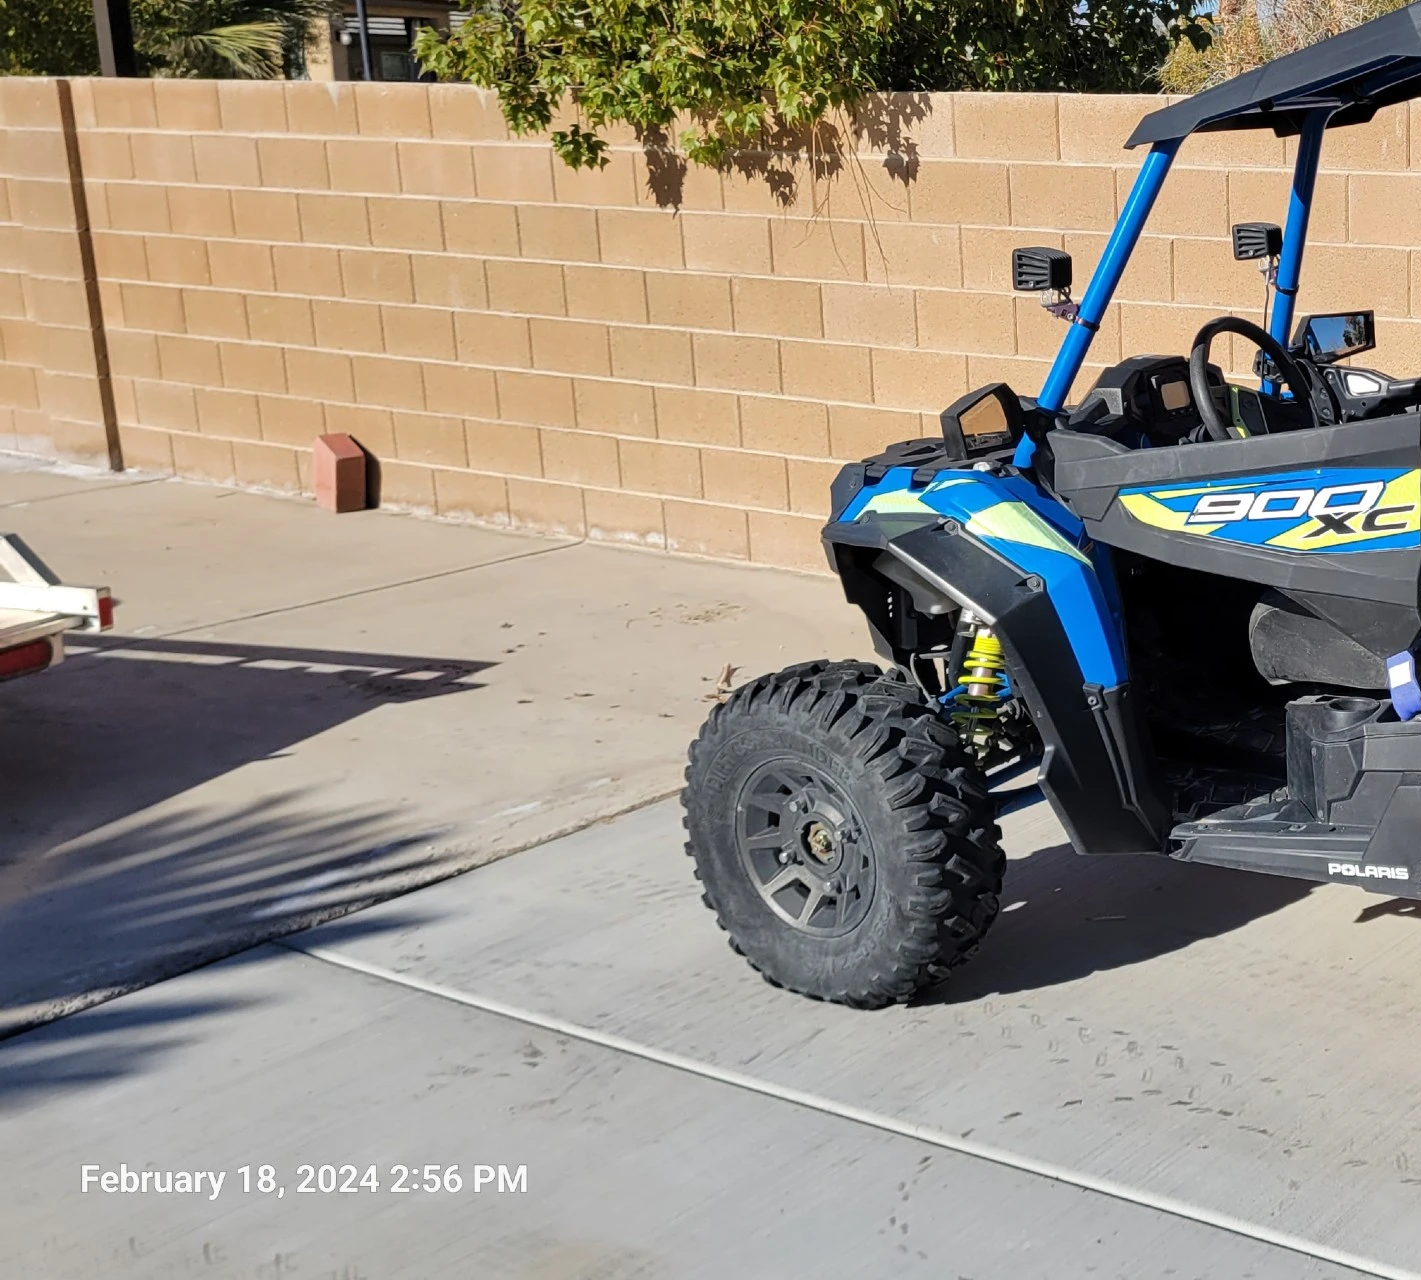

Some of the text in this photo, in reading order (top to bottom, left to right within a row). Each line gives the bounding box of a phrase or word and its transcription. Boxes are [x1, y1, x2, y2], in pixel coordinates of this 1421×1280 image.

[1187, 480, 1388, 524] 900
[1302, 504, 1415, 540] XC
[1328, 862, 1409, 880] POLARIS
